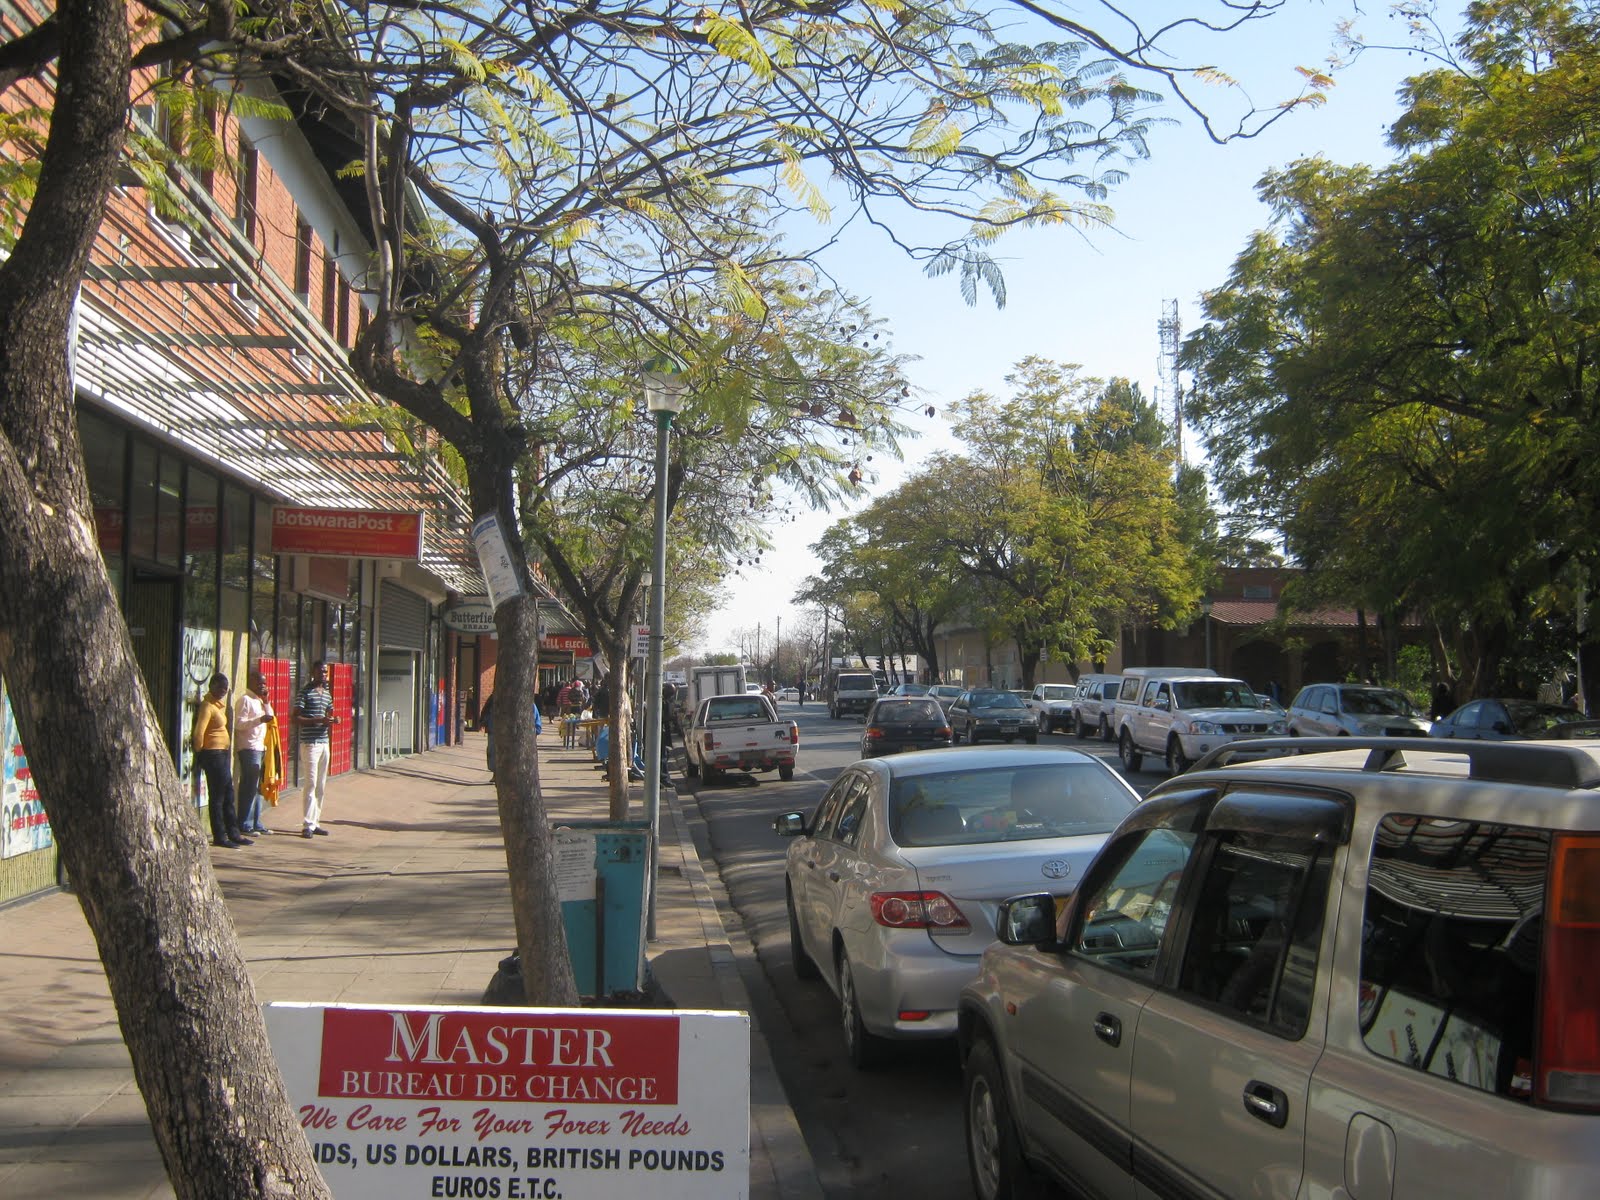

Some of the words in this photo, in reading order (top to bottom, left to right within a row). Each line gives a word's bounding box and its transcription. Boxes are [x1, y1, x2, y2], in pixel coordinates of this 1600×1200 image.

[276, 510, 393, 531] BotswanaPost
[385, 1012, 614, 1067] MASTER
[341, 1071, 466, 1097] BUREAU
[475, 1074, 518, 1098] DE
[525, 1075, 657, 1101] CHANGE
[299, 1104, 337, 1130] We
[346, 1104, 407, 1131] Care
[417, 1107, 462, 1137] For
[473, 1108, 534, 1141] Your
[543, 1109, 611, 1139] Forex
[619, 1110, 691, 1137] Needs
[366, 1144, 397, 1165] US
[405, 1145, 518, 1172] DOLLARS,
[527, 1147, 620, 1169] BRITISH
[629, 1149, 724, 1172] POUNDS
[432, 1176, 501, 1199] EUROS
[507, 1177, 562, 1200] E.T.C.
